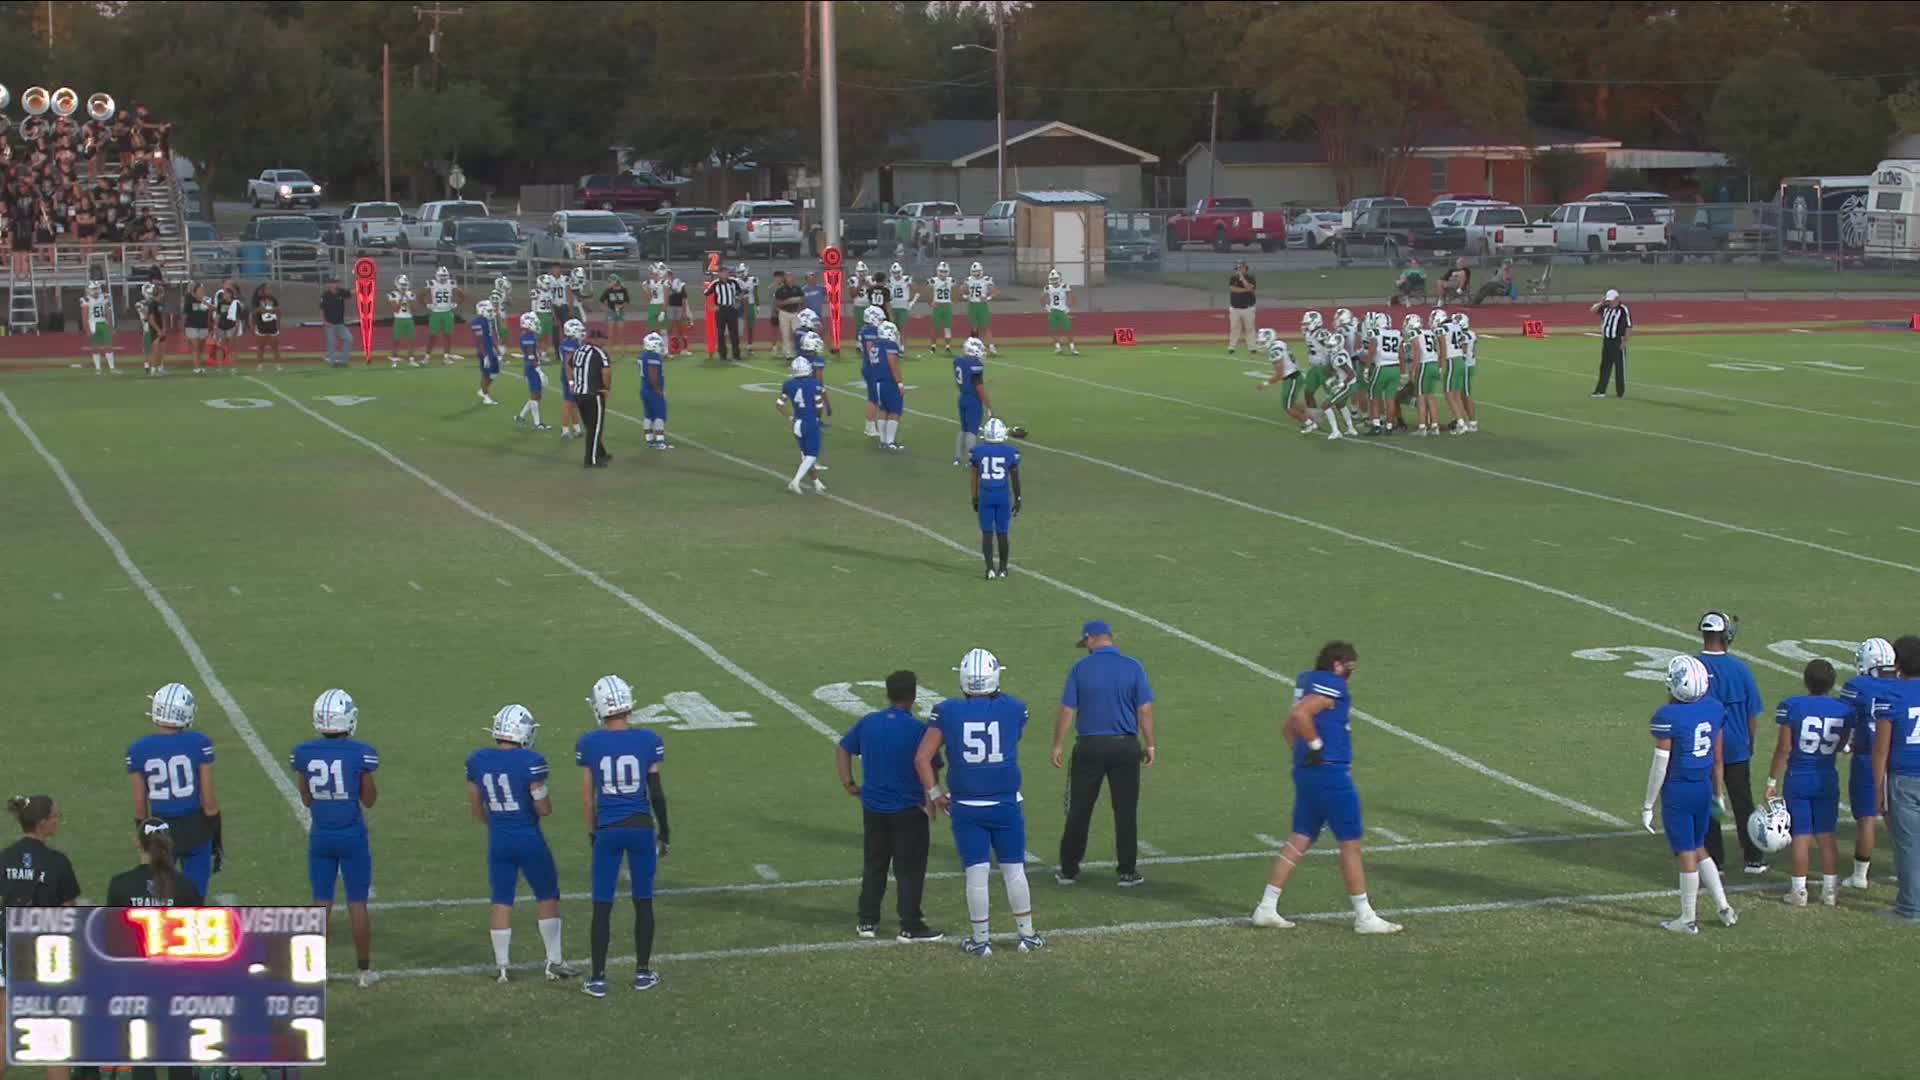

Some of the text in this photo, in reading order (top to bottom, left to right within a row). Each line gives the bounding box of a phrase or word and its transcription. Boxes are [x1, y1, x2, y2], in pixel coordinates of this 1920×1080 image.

[1878, 171, 1902, 185] LIONS
[708, 253, 720, 272] 2
[435, 290, 450, 303] 55
[871, 293, 884, 306] 10
[1119, 329, 1134, 342] 20
[1382, 336, 1399, 352] 52
[794, 388, 805, 408] 4
[981, 457, 1006, 480] 15
[962, 721, 1004, 763] 51
[1692, 721, 1713, 757] 6
[1800, 715, 1845, 755] 65
[145, 754, 195, 800] 20
[307, 759, 349, 800] 21
[600, 755, 641, 795] 10
[483, 773, 520, 812] 11
[6, 868, 46, 883] TRAINR
